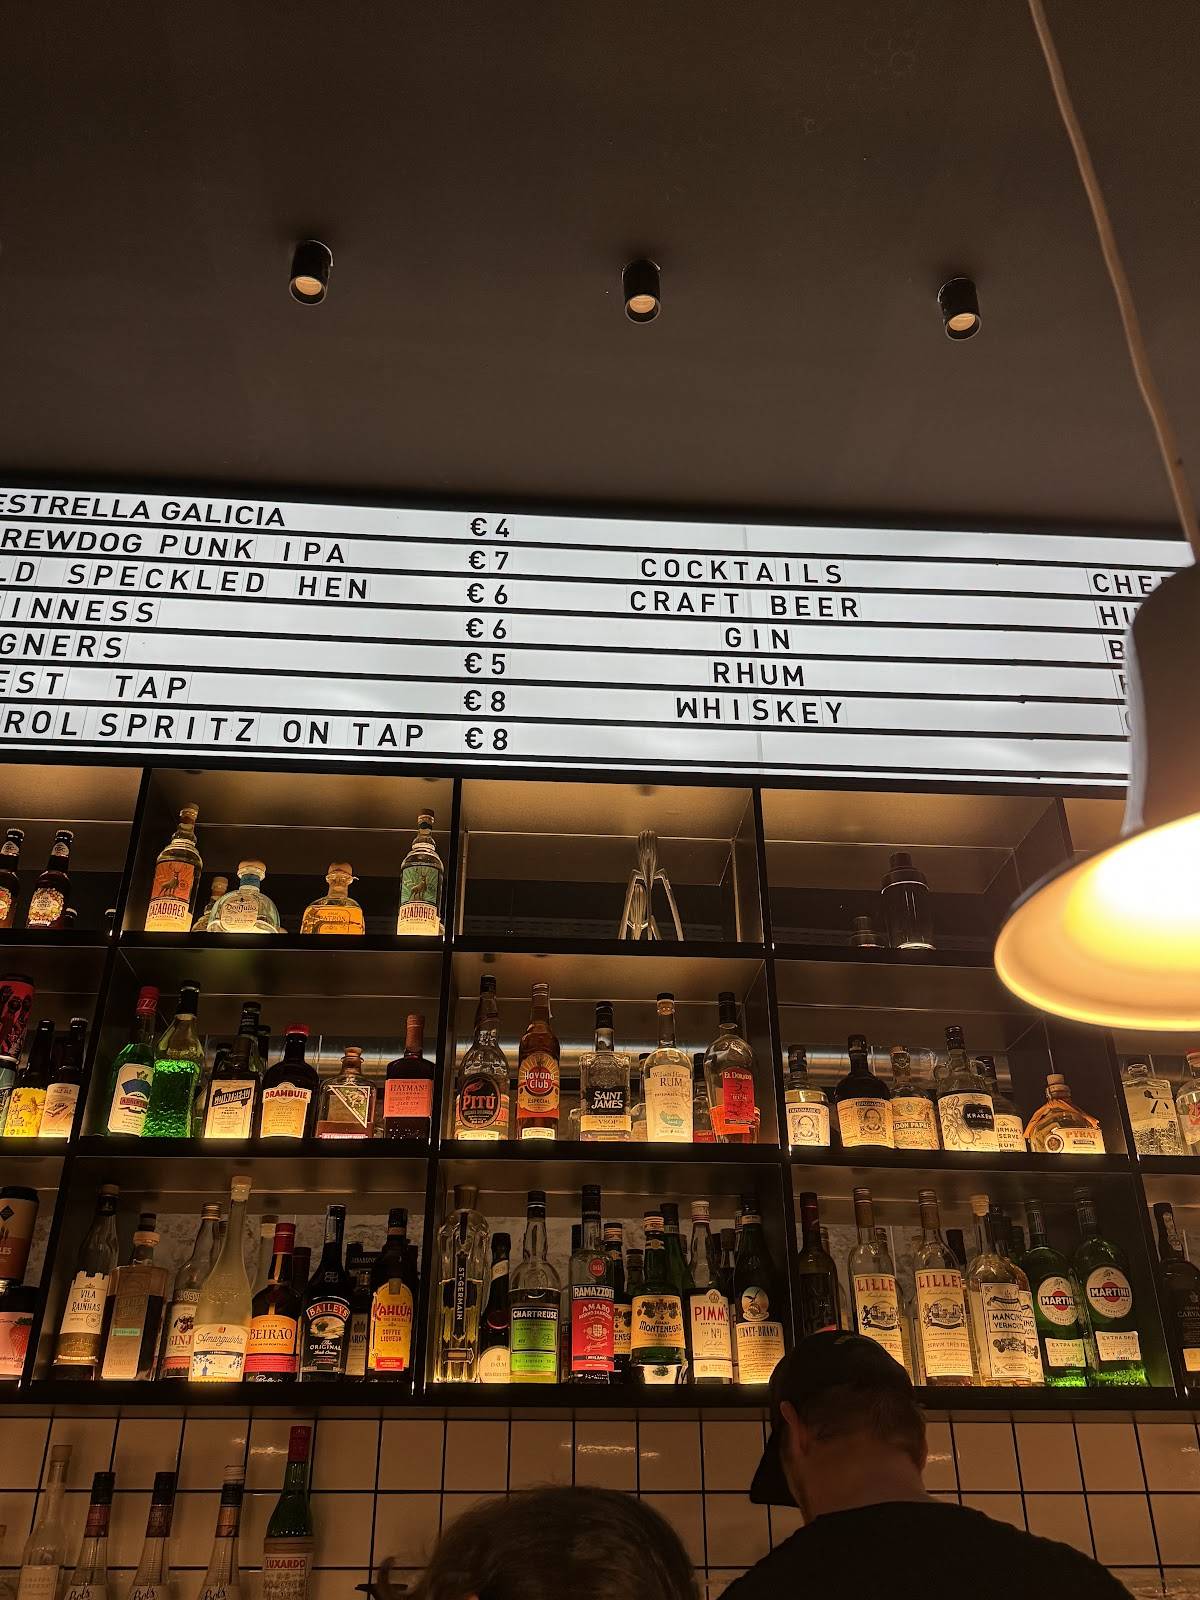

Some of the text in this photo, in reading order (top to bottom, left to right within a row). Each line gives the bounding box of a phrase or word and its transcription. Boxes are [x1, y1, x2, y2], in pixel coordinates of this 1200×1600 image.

[161, 502, 285, 526] GALICIA
[1, 529, 344, 563] REWDOG PUNK IPA
[642, 559, 841, 583] COCKTAILS
[0, 562, 366, 599] D SPECKLED HEN
[1093, 573, 1169, 594] CHE
[631, 591, 858, 617] CRAFT BEER
[0, 634, 122, 658] GNERS
[726, 628, 789, 649] GIN
[714, 662, 804, 686] RHUM
[115, 675, 186, 698] TAP
[677, 698, 841, 723] WHISKEY
[99, 713, 254, 741] SPRITZ
[284, 720, 328, 744] ON
[353, 723, 423, 746] TAP
[524, 1071, 554, 1081] Havana
[529, 1079, 549, 1089] Club
[660, 1077, 683, 1086] RUM
[265, 1089, 308, 1100] DRAMBUIE
[462, 1093, 495, 1111] PITÚ
[593, 1090, 623, 1100] SAINT
[591, 1100, 624, 1109] JAMES
[80, 1289, 96, 1299] VILA
[457, 1267, 465, 1321] ST-GERMAIN
[1090, 1287, 1131, 1298] MARTINI
[308, 1302, 350, 1320] BAILEYS
[373, 1302, 412, 1321] KAHLÚA
[512, 1309, 557, 1320] CHARTREUSE
[582, 1304, 610, 1313] AMARO
[249, 1327, 293, 1341] BEIRÃO
[266, 1559, 306, 1569] LUXARDO
